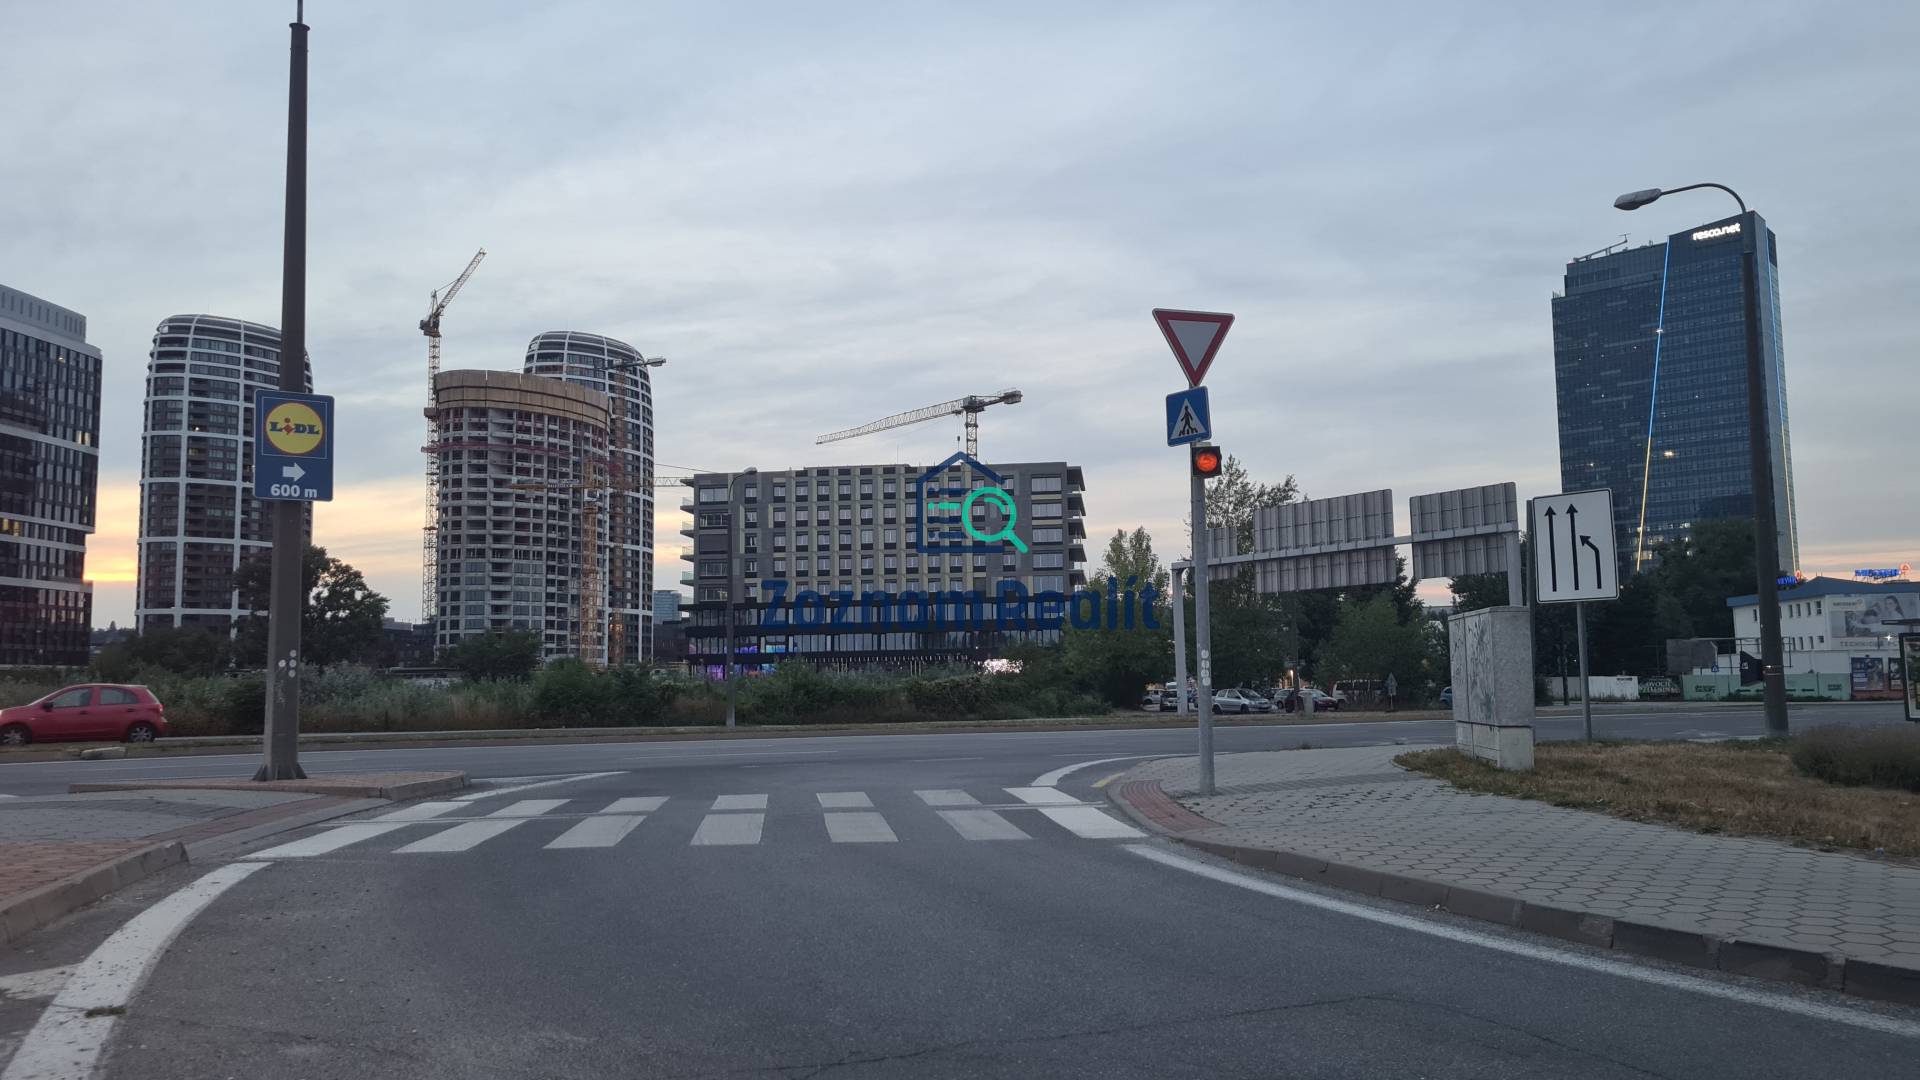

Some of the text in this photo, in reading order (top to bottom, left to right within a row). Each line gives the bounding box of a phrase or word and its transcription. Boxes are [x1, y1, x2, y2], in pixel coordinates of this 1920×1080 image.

[1693, 223, 1740, 240] resco.net
[269, 417, 320, 435] LIDL
[271, 484, 317, 498] 600 m
